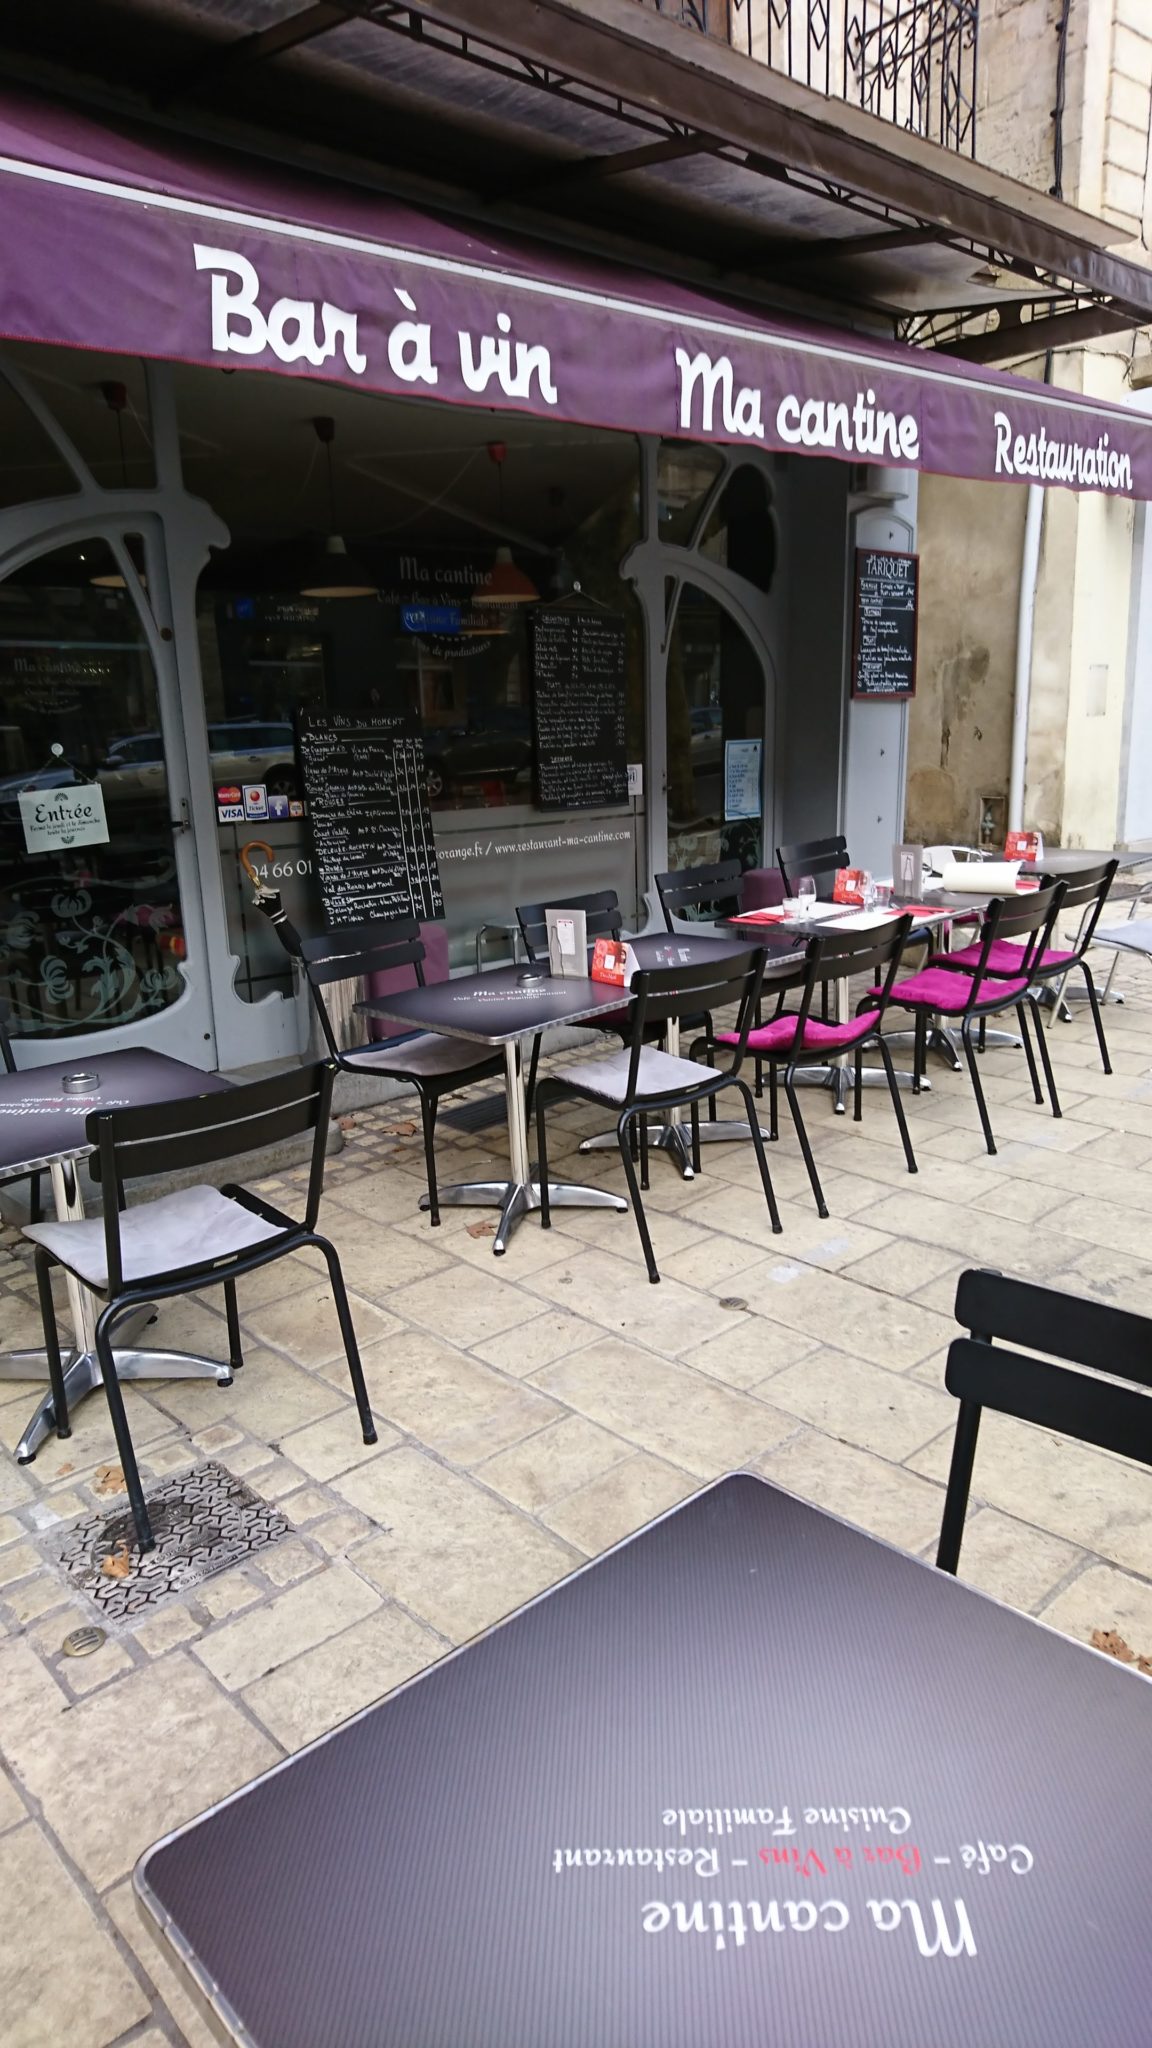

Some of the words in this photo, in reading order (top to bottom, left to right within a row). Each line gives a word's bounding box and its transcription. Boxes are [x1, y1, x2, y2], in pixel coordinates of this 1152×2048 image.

[193, 243, 367, 374] Bar
[388, 287, 438, 384] à
[458, 312, 558, 404] vin
[676, 347, 764, 438] Ma
[776, 389, 920, 460] cantine
[994, 411, 1133, 490] Restauration
[400, 556, 430, 581] Ma
[866, 559, 910, 579] TARIQUET
[35, 804, 93, 823] Entrée
[221, 809, 243, 819] VISA
[494, 830, 631, 855] www.restaurant-ma-cantine.com
[272, 862, 293, 878] 66
[297, 859, 312, 876] 01
[662, 1805, 797, 1836] Familiale
[803, 1806, 912, 1835] Cuisine
[552, 1846, 720, 1877] Restaurant
[758, 1845, 828, 1878] Vins
[833, 1845, 852, 1871] à
[863, 1843, 922, 1876] Bar
[959, 1839, 1035, 1875] Café
[640, 1899, 851, 1952] cantine
[866, 1896, 979, 1958] Ma
